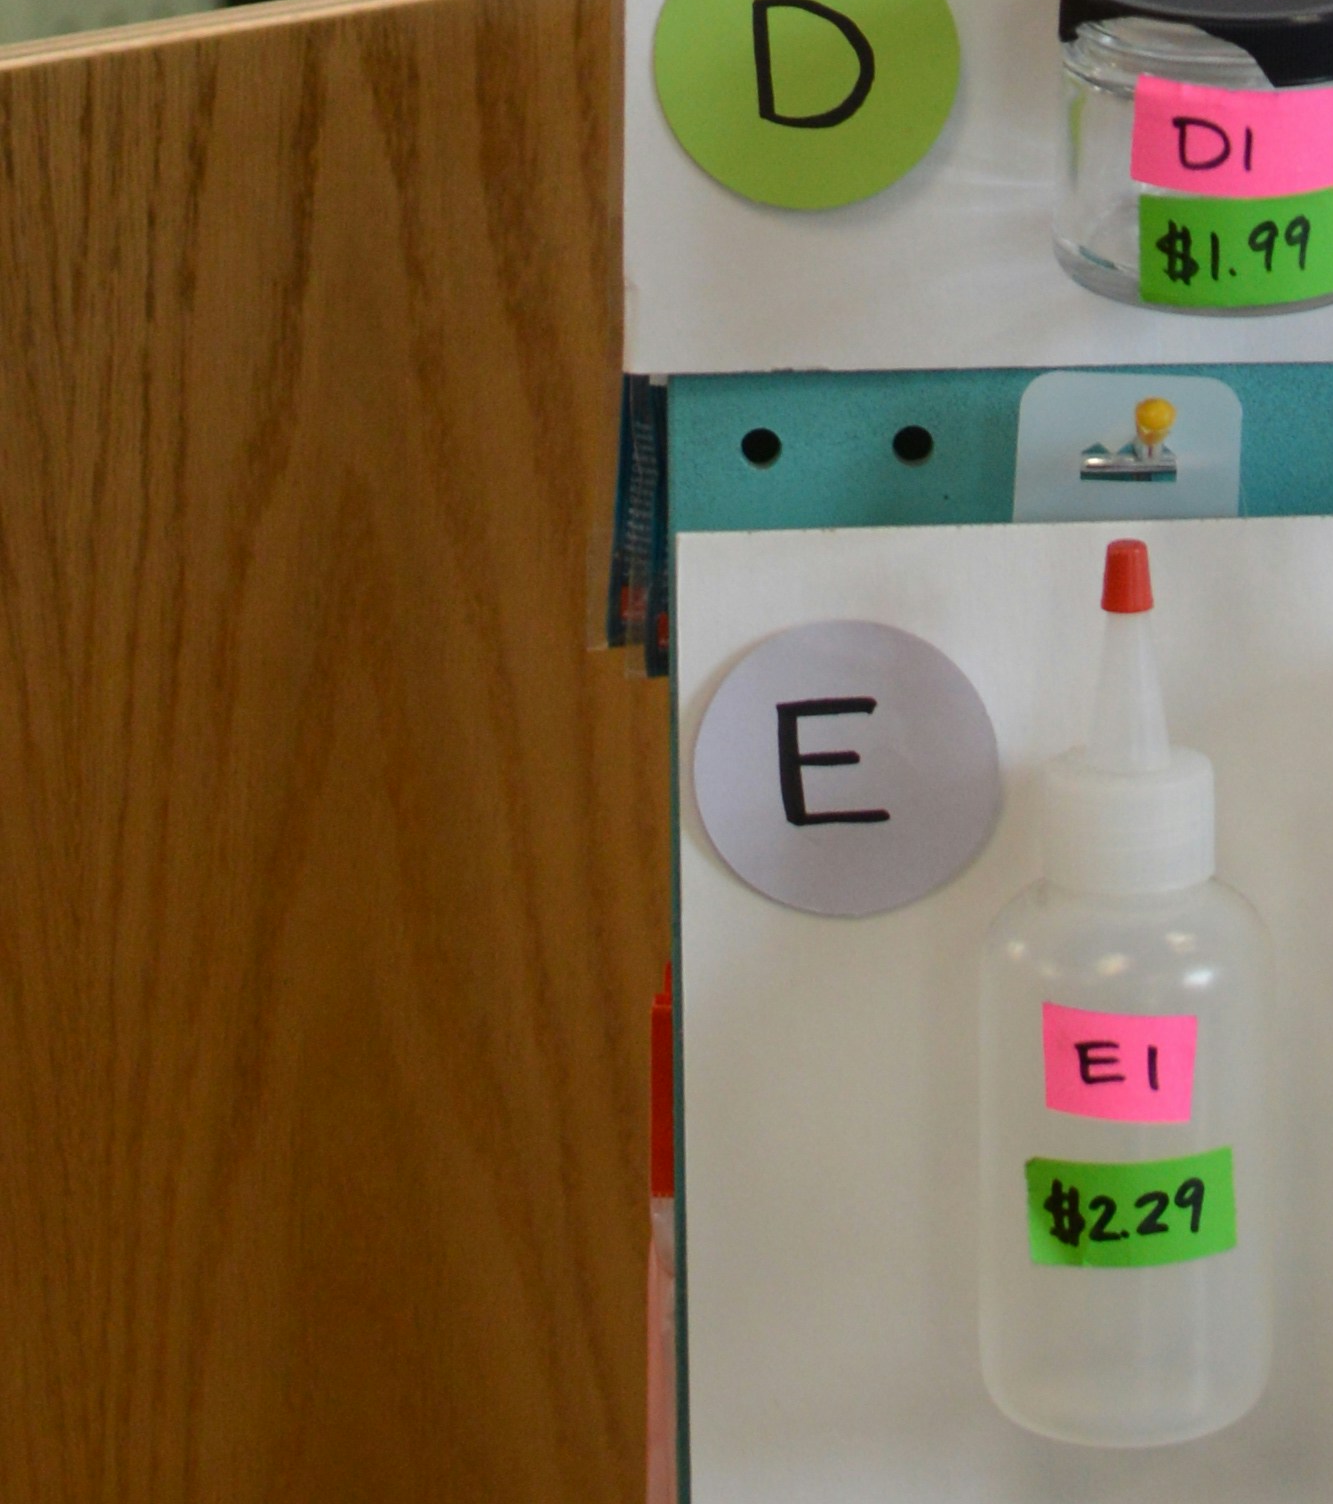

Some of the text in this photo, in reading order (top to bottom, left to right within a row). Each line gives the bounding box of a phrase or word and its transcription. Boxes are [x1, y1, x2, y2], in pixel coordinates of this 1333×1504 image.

[1172, 115, 1255, 173] D1
[1155, 212, 1312, 287] $1.99
[776, 695, 891, 827] E
[1073, 1038, 1159, 1091] E1
[1042, 1176, 1206, 1247] $2.29
